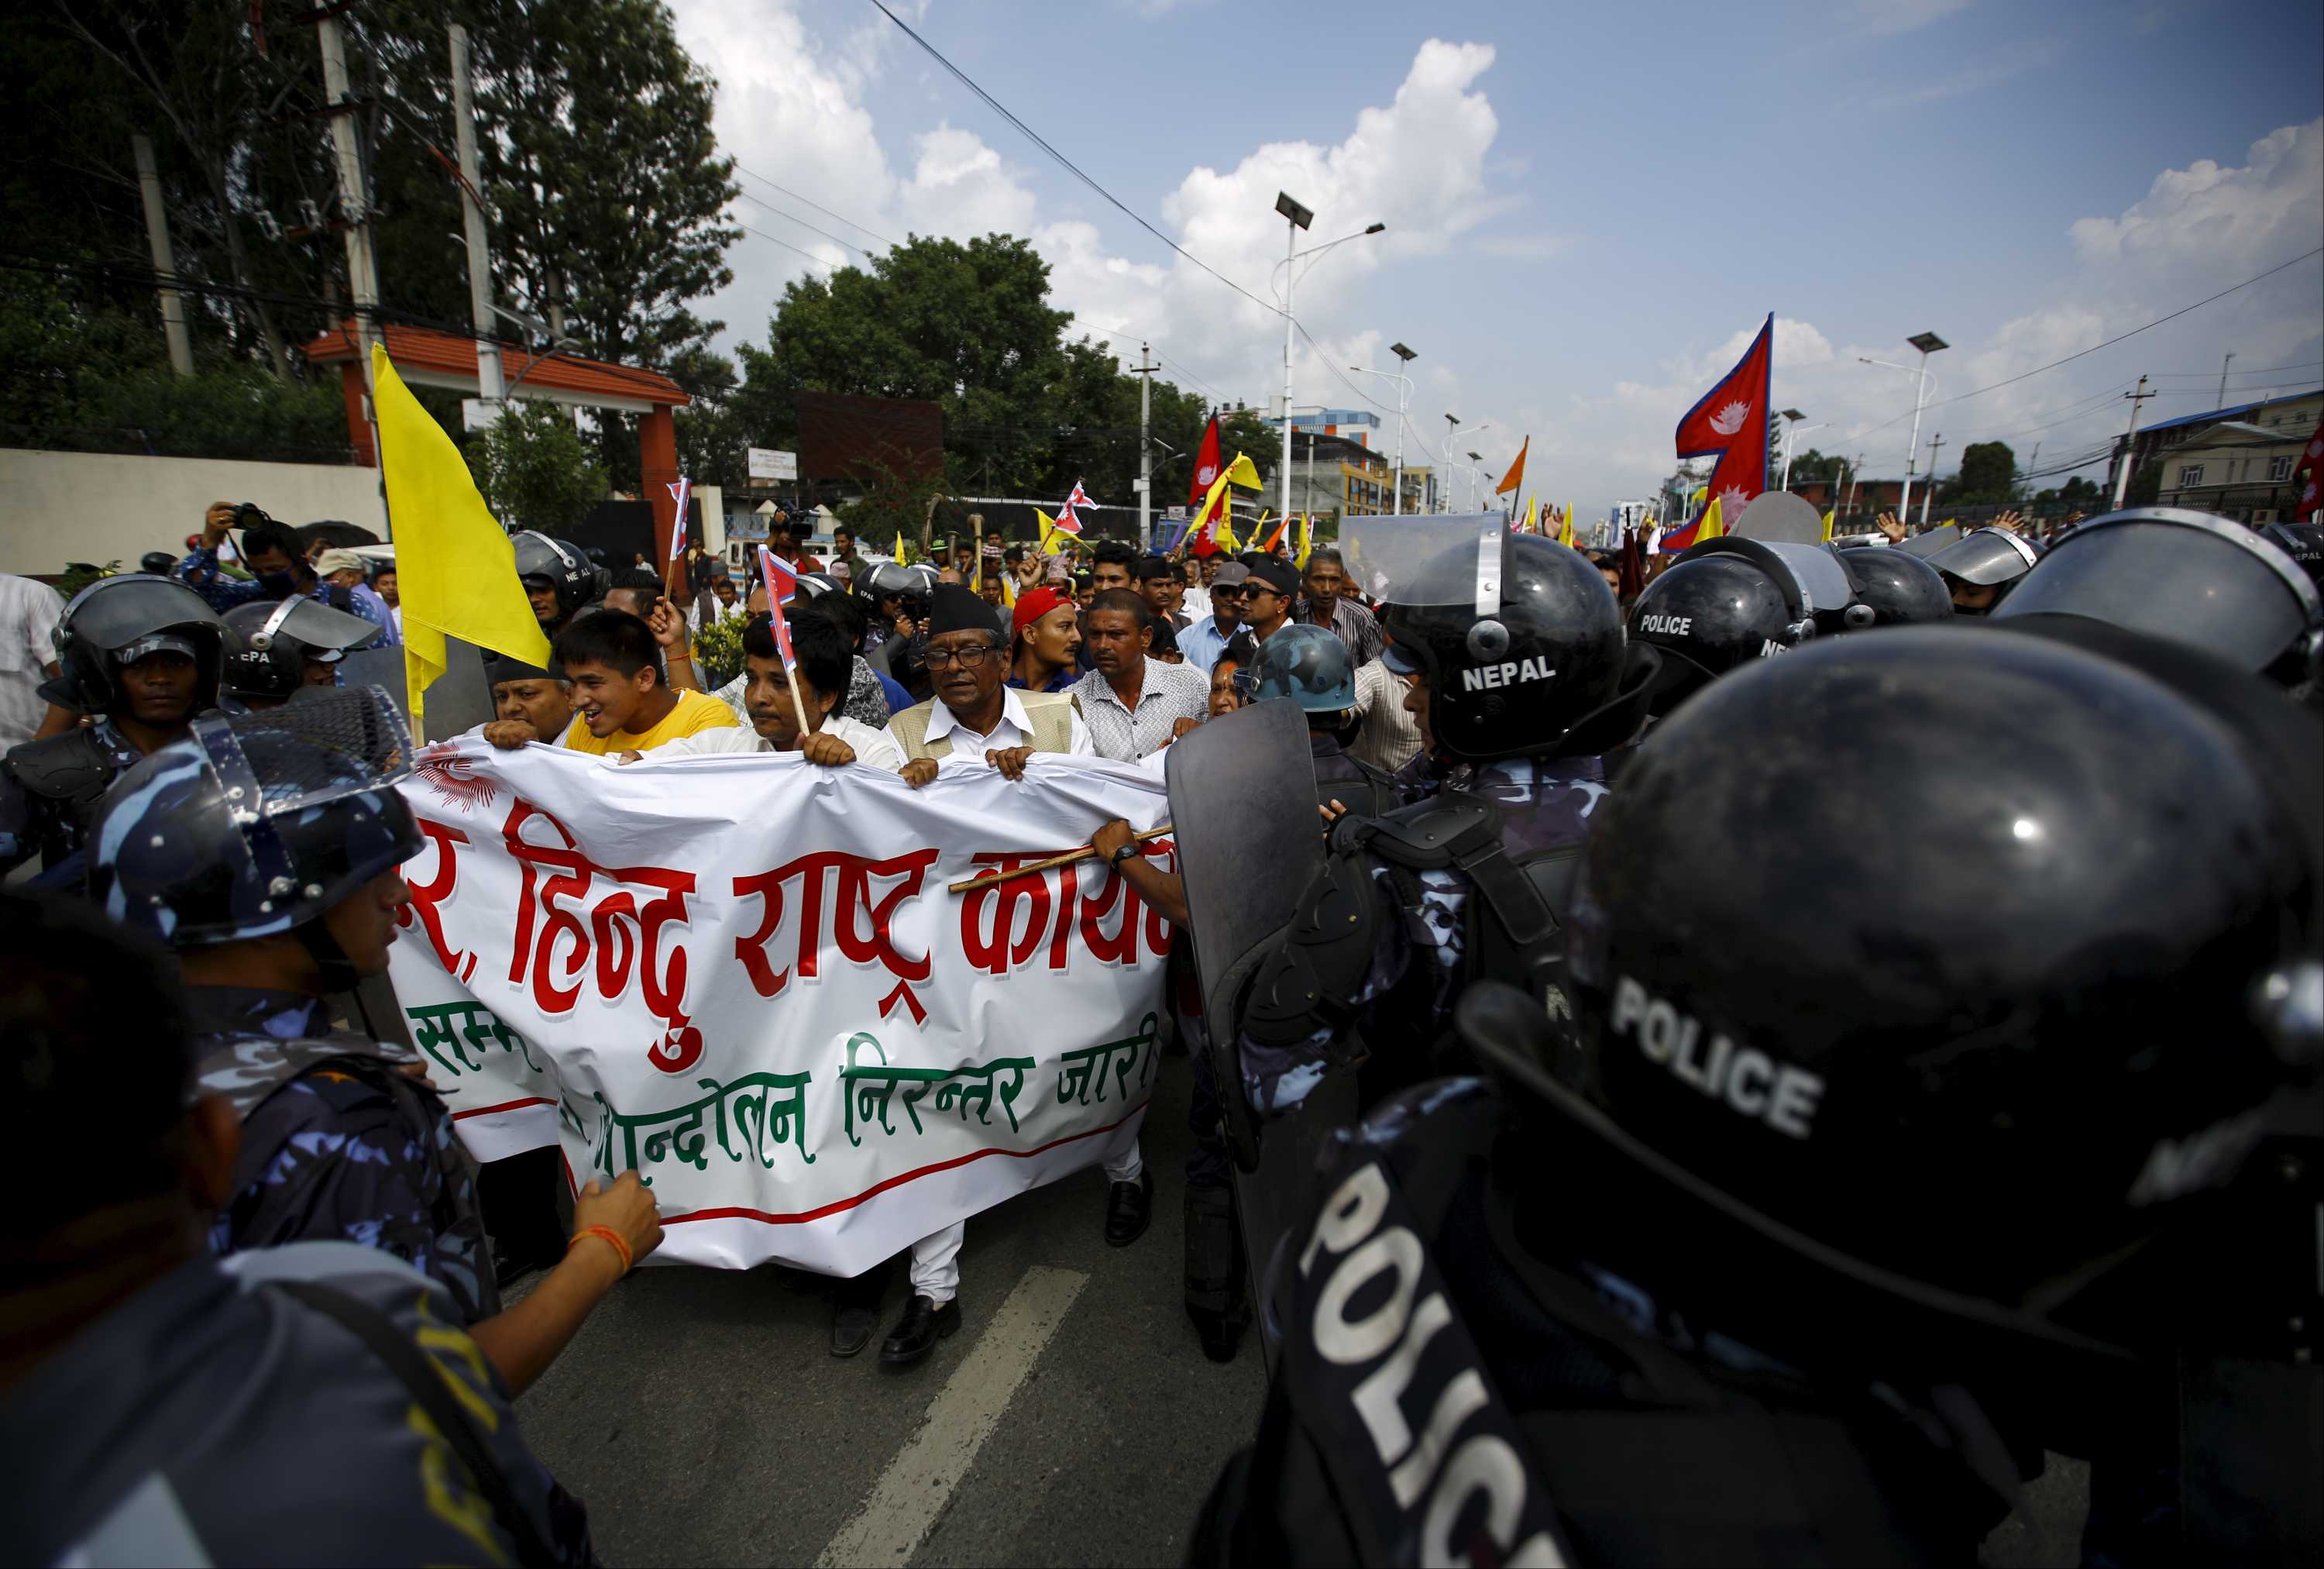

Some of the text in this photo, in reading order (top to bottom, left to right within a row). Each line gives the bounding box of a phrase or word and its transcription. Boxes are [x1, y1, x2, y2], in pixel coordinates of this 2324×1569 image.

[2295, 552, 2322, 560] EPAL
[1462, 655, 1556, 691] NEPAL
[1640, 614, 1693, 636] POLICE
[733, 848, 940, 1026] राष्ट्र
[839, 1032, 1037, 1148] निरन्तर
[1614, 976, 1826, 1140] POLICE
[1298, 1162, 1568, 1569] POLIC
